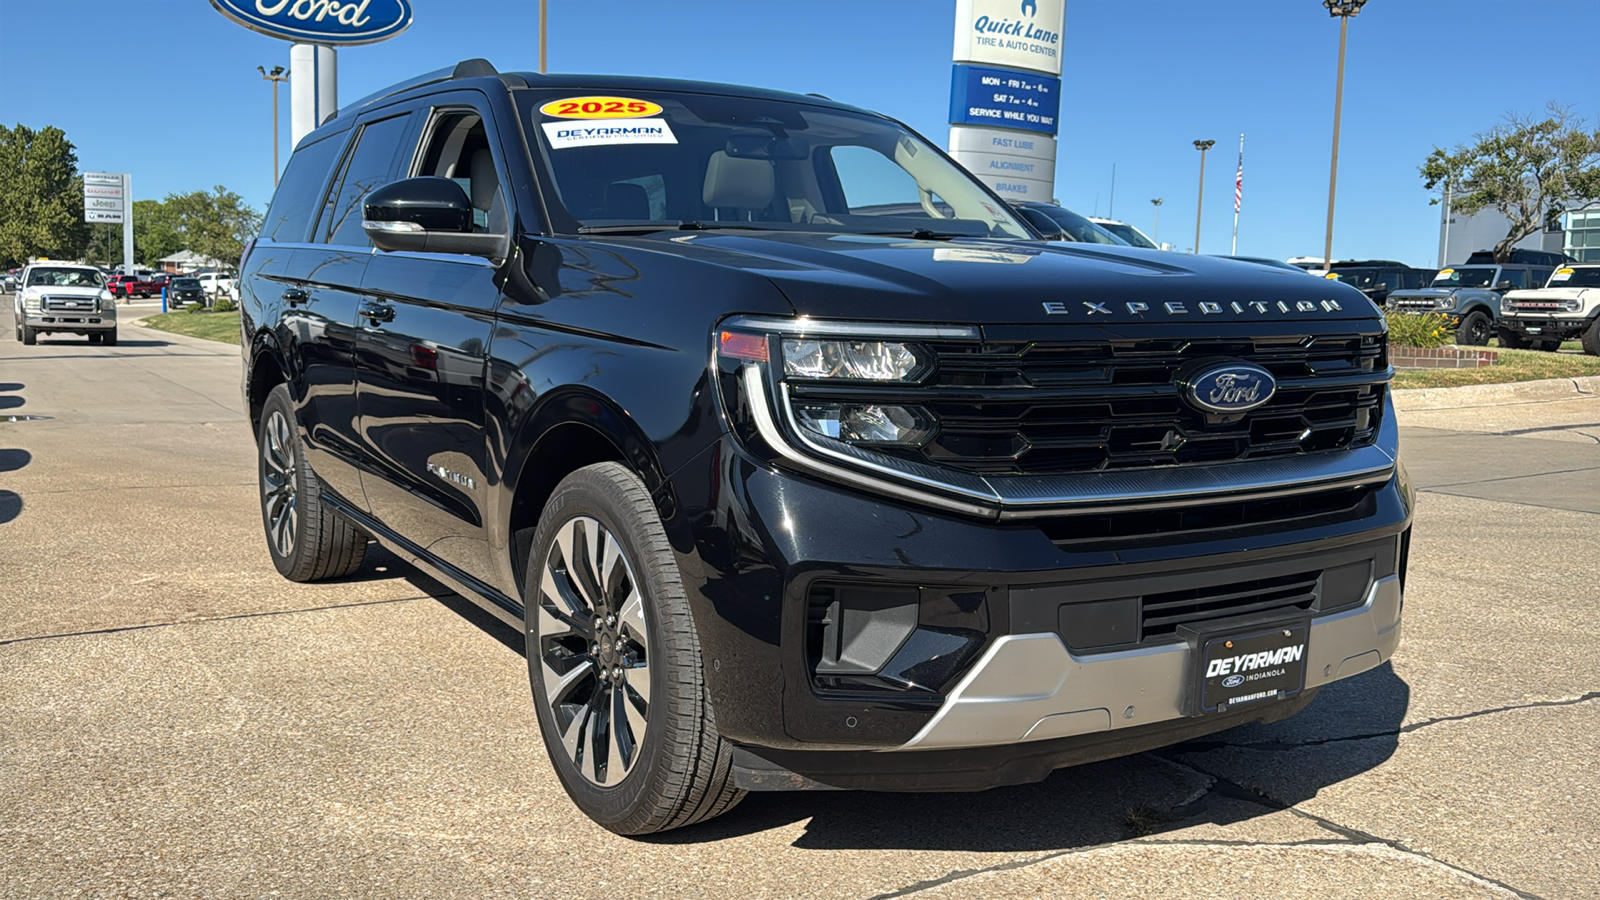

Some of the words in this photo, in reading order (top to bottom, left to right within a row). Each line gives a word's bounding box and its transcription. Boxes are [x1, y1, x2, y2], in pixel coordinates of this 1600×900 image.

[974, 15, 1024, 36] Quick
[1024, 23, 1058, 44] Lane
[976, 36, 996, 46] TIRE
[998, 39, 1004, 48] &
[1006, 40, 1028, 51] AUTO
[1029, 43, 1056, 58] CENTER
[982, 76, 1000, 86] MON
[1008, 80, 1019, 88] FRI
[993, 94, 1007, 102] SAT
[558, 102, 648, 114] 2025
[969, 107, 1002, 118] SERVICE
[1004, 110, 1025, 121] WHILE
[1026, 113, 1039, 123] YOU
[1041, 116, 1053, 125] WAIT
[557, 127, 662, 138] DEYARMAN
[992, 137, 1013, 147] FAST
[1014, 140, 1034, 150] LUBE
[990, 160, 1034, 172] ALIGNMENT
[996, 182, 1027, 194] BRAKES
[92, 199, 116, 208] Jeep
[1042, 300, 1342, 315] EXPEDITION
[1210, 373, 1262, 403] Ford
[1206, 644, 1304, 678] DEYARMAN
[1246, 668, 1285, 682] INDIANOLA
[1229, 689, 1278, 704] DEYARMANFORD.COM
